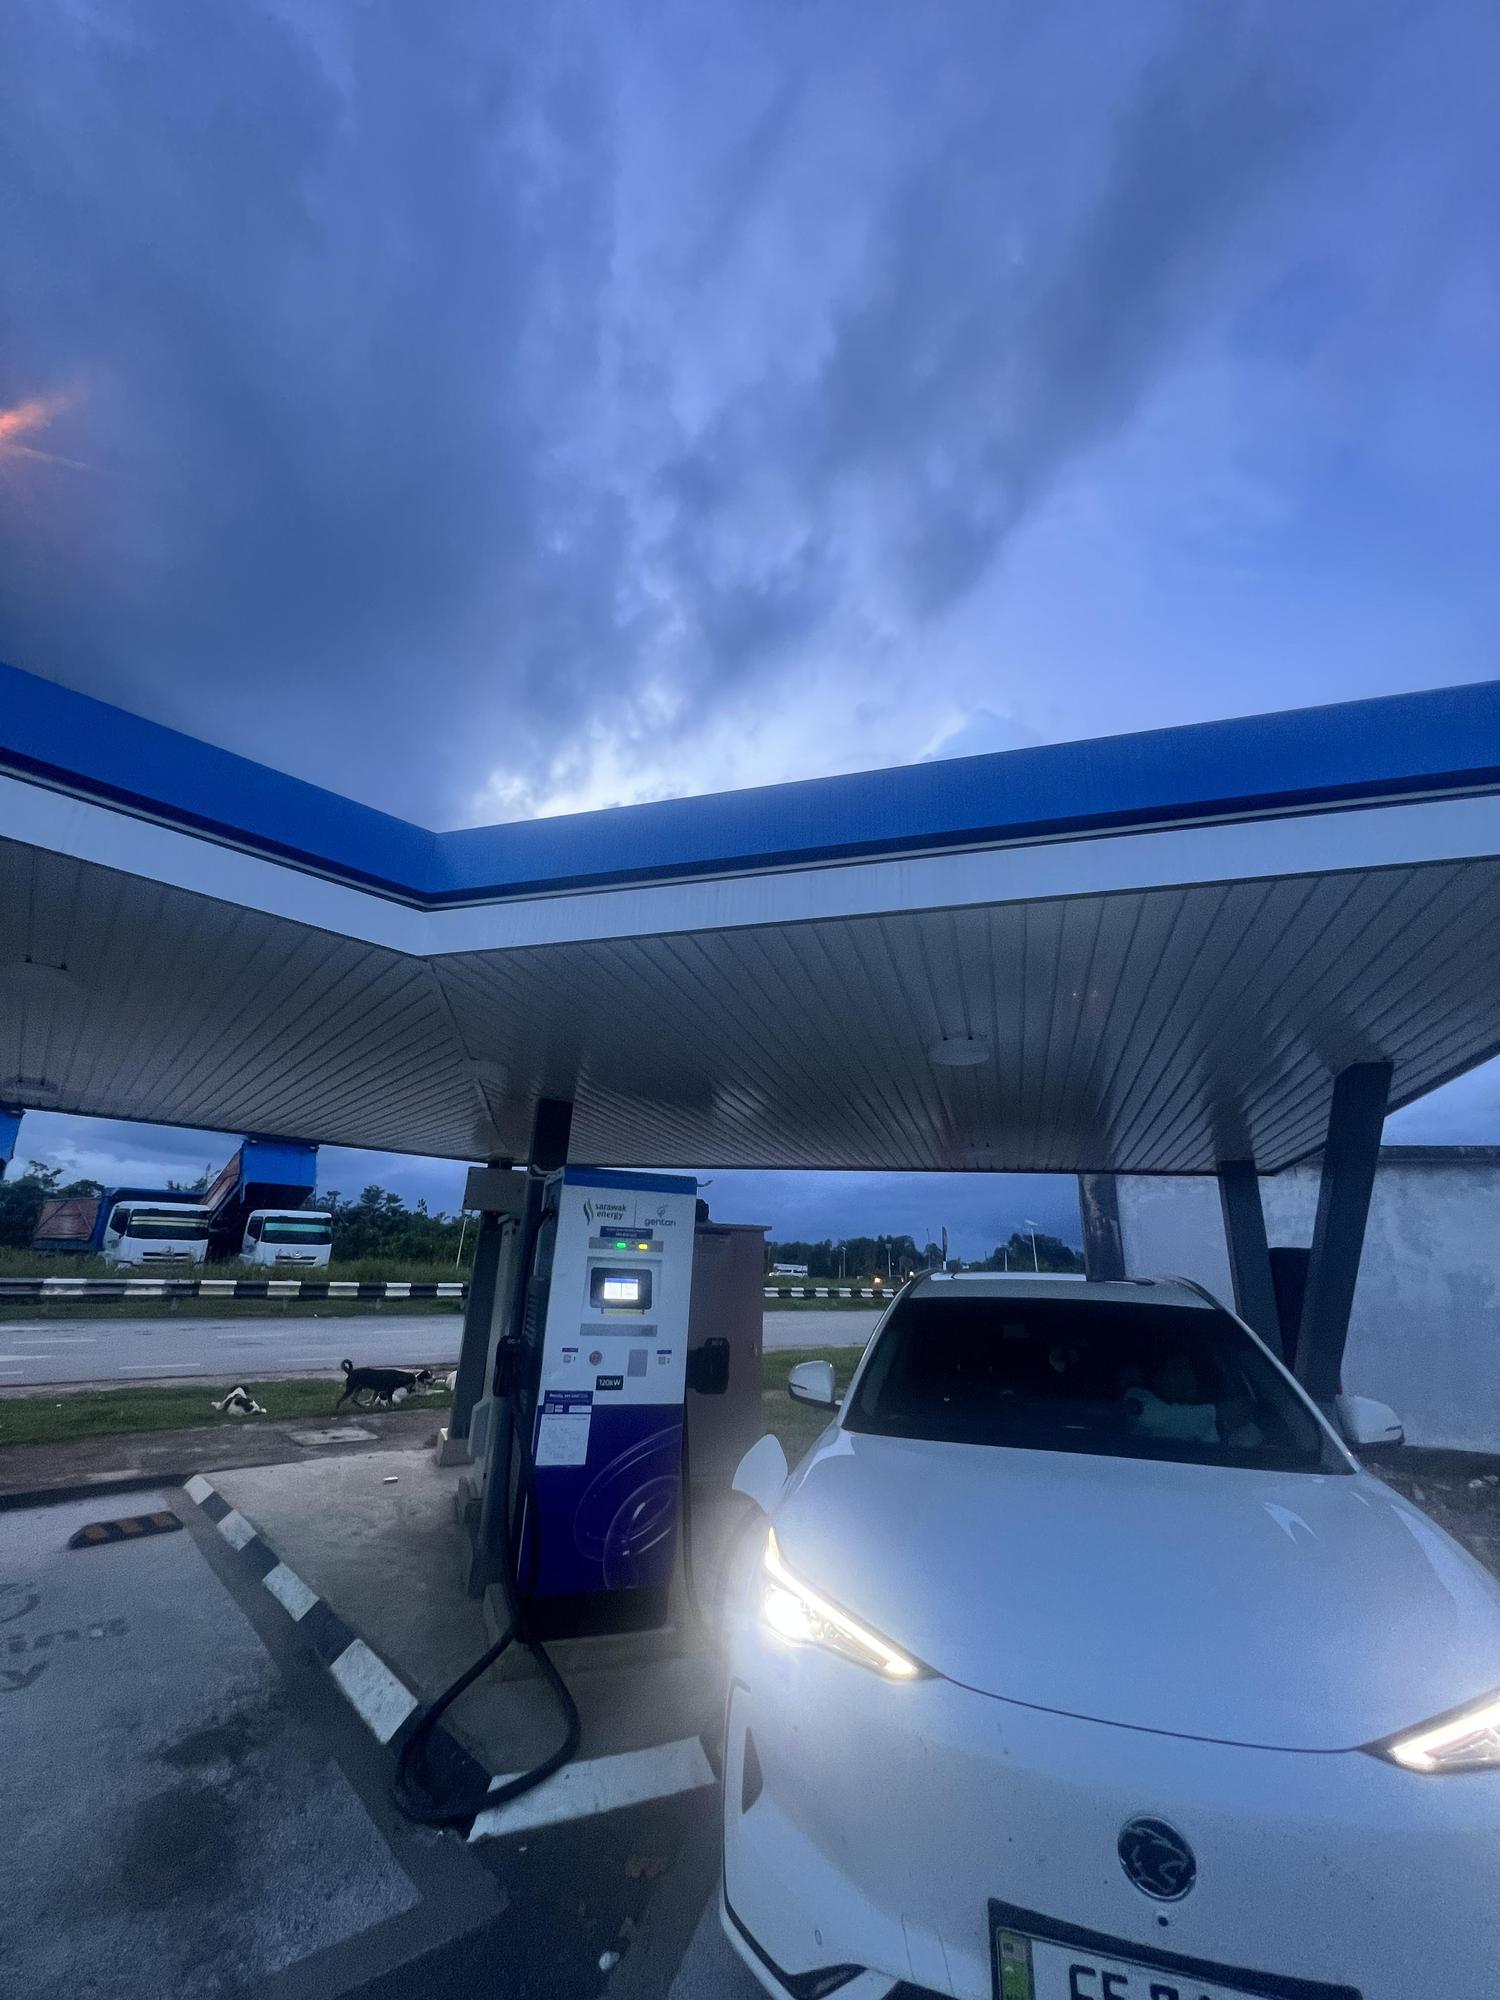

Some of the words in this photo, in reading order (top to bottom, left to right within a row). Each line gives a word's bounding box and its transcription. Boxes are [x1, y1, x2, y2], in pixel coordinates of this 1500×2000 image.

[595, 1203, 627, 1211] sarawak
[596, 1211, 624, 1220] energy
[599, 1378, 621, 1386] 120kW
